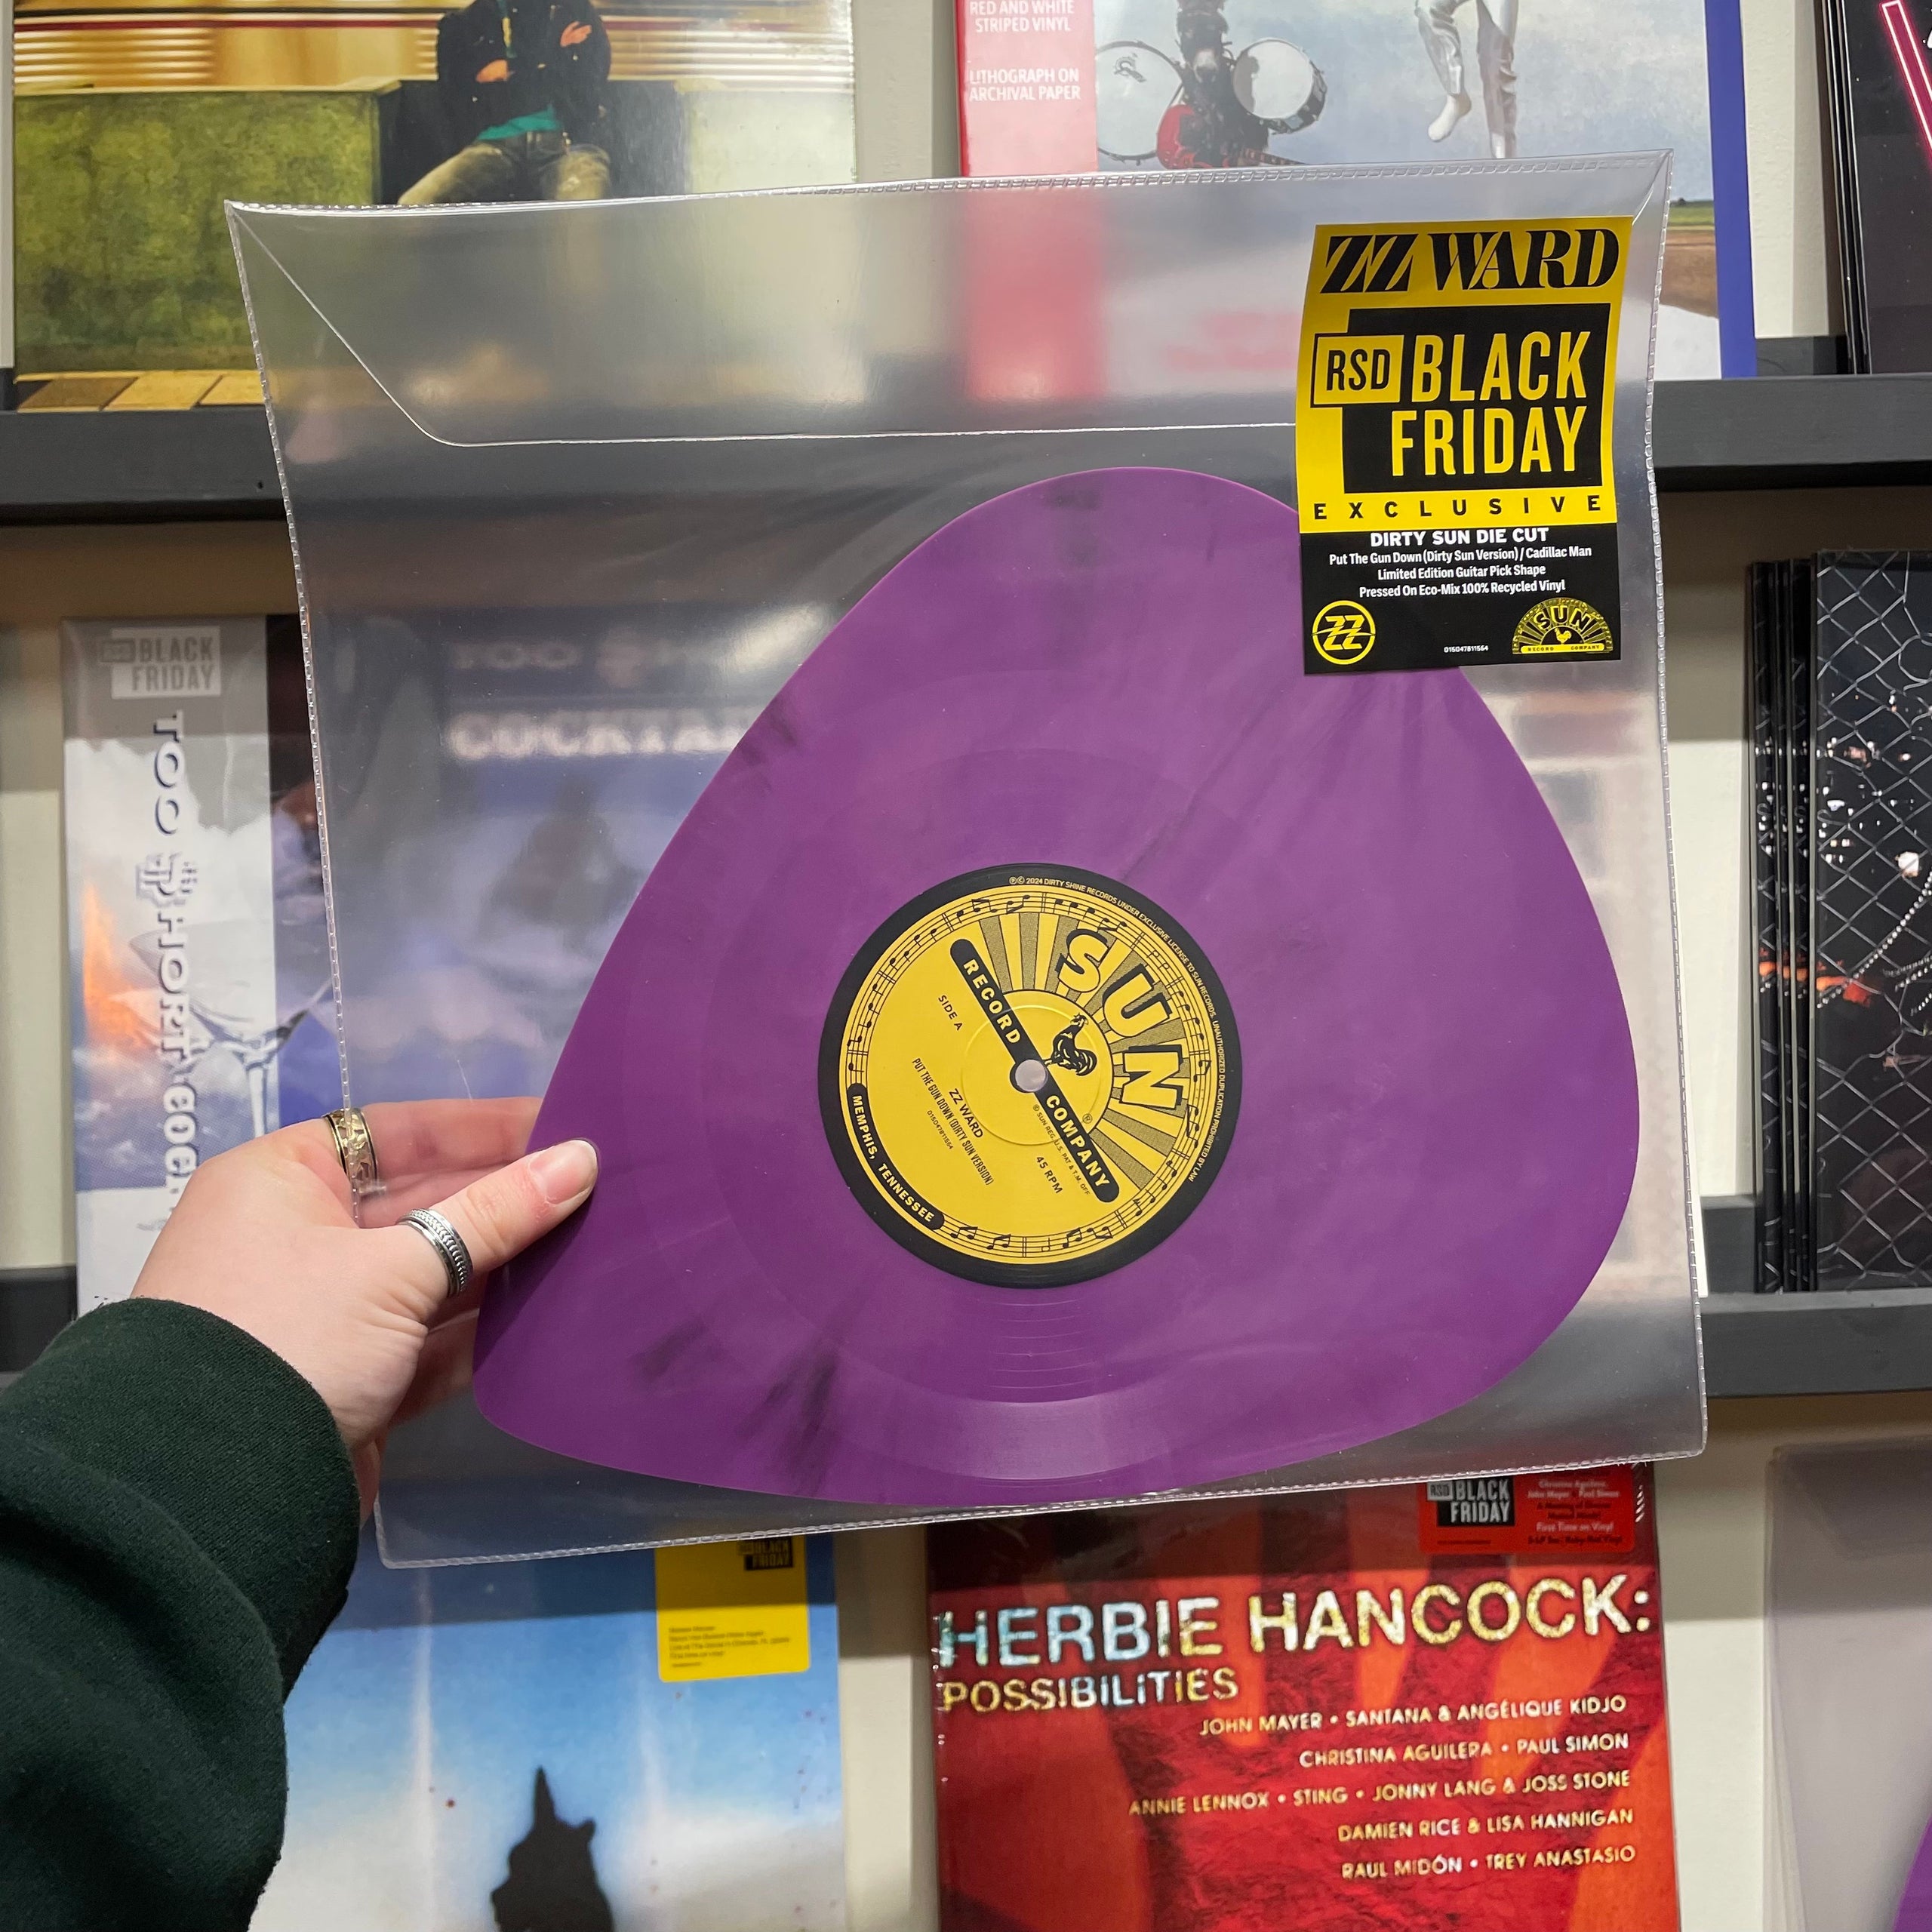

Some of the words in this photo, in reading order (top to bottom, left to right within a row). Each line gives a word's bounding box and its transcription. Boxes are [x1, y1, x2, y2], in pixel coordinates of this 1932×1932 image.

[970, 1, 997, 15] RED
[999, 0, 1029, 14] AND
[1032, 0, 1075, 14] WHITE
[975, 17, 1029, 32] STRIPED
[1032, 17, 1071, 32] VINYL
[969, 68, 1055, 85] LITHOGRAPH
[1058, 68, 1079, 82] ON
[969, 86, 1036, 101] ARCHIVAL
[1038, 85, 1081, 100] PAPER
[1320, 233, 1418, 294] ZZ
[1428, 229, 1619, 291] WARD
[1326, 348, 1391, 391] RSD
[1411, 331, 1590, 402] BLACK
[1391, 406, 1587, 476] FRIDAY
[1314, 495, 1601, 520] EXCLUSIVE
[1370, 531, 1426, 547] DIRTY
[1432, 530, 1470, 545] SUN
[1476, 529, 1507, 543] DIE
[1512, 528, 1549, 543] CUT
[1330, 554, 1347, 565] Put
[1349, 553, 1368, 565] The
[1370, 552, 1391, 564] Gun
[1392, 552, 1422, 563] Down
[1423, 549, 1453, 564] (Dirty
[1454, 550, 1474, 561] Sun
[1475, 546, 1518, 561] Version)
[1525, 546, 1567, 559] Cadillac
[1569, 546, 1592, 557] Man
[1378, 568, 1417, 580] Limited
[1418, 567, 1454, 579] Edition
[1455, 566, 1488, 578] Guitar
[1490, 565, 1512, 577] Pick
[1513, 565, 1546, 577] Shape
[1359, 585, 1401, 598] Pressed
[1402, 585, 1417, 596] On
[1419, 583, 1460, 595] Eco-Mix
[1462, 583, 1490, 594] 100%
[1491, 580, 1537, 595] Recycled
[1539, 580, 1566, 593] Vinyl
[1533, 605, 1591, 632] SUN
[140, 636, 213, 663] BLACK
[131, 664, 214, 691] FRIDAY
[1044, 878, 1065, 887] DIRTY
[1065, 881, 1087, 891] SHINE
[1086, 888, 1118, 904] RECORDS
[1117, 900, 1140, 917] UNDER
[1139, 912, 1171, 941] EXCLUSIVE
[1168, 939, 1189, 964] LICENSE
[1186, 962, 1195, 973] TO
[1192, 971, 1204, 986] SUN
[938, 994, 958, 1020] SIDE
[954, 1021, 964, 1031] A
[1055, 928, 1183, 1109] SUN
[1212, 1020, 1226, 1073] UNAUTHORIZED
[964, 958, 1021, 1044] RECORD
[1046, 1095, 1110, 1186] COMPANY
[1214, 1074, 1226, 1119] DUPLICATION
[912, 1057, 926, 1073] PUT
[920, 1071, 934, 1086] THE
[928, 1084, 942, 1100] GUN
[937, 1098, 955, 1121] DOWN
[949, 1118, 968, 1141] (DIRTY
[962, 1140, 976, 1156] SUN
[971, 1154, 994, 1186] VERSION)
[949, 1088, 964, 1105] ZZ
[959, 1103, 983, 1138] WARD
[1036, 1112, 1047, 1126] SUN
[1201, 1120, 1220, 1158] PROHIBITED
[852, 1095, 878, 1160] MEMPHIS,
[878, 1163, 935, 1223] TENNESSEE
[1196, 1158, 1205, 1168] BY
[1037, 1156, 1048, 1169] 45
[1044, 1170, 1063, 1194] RPM
[1188, 1168, 1201, 1182] LAW
[1455, 1479, 1509, 1500] BLACK
[1451, 1501, 1510, 1523] FRIDAY
[939, 1598, 1223, 1668] HERBIE
[1247, 1574, 1651, 1652] HANCOCK:
[1199, 1717, 1253, 1736] JOHN
[1259, 1712, 1323, 1731] MAYER
[1346, 1707, 1432, 1727] SANTANA
[1438, 1705, 1451, 1722] &
[1570, 1694, 1627, 1715] KIDJO
[1299, 1746, 1395, 1768] CHRISTINA
[1402, 1742, 1493, 1761] AGUILERA
[1516, 1737, 1560, 1755] PAUL
[1565, 1733, 1629, 1753] SIMON
[1129, 1796, 1186, 1816] ANNIE
[1193, 1792, 1269, 1813] LENNOX
[1294, 1786, 1348, 1806] STING
[1372, 1782, 1438, 1802] JONNY
[1444, 1777, 1496, 1798] LANG
[1522, 1774, 1567, 1793] JOSS
[1573, 1770, 1630, 1790] STONE
[1337, 1821, 1413, 1842] DAMIEN
[1419, 1818, 1461, 1838] RICE
[1467, 1817, 1480, 1834] &
[1487, 1814, 1524, 1834] LISA
[1531, 1808, 1633, 1830] HANNIGAN
[1341, 1861, 1388, 1880] RAUL
[1486, 1853, 1527, 1870] TREY
[1534, 1844, 1635, 1867] ANASTASIO
